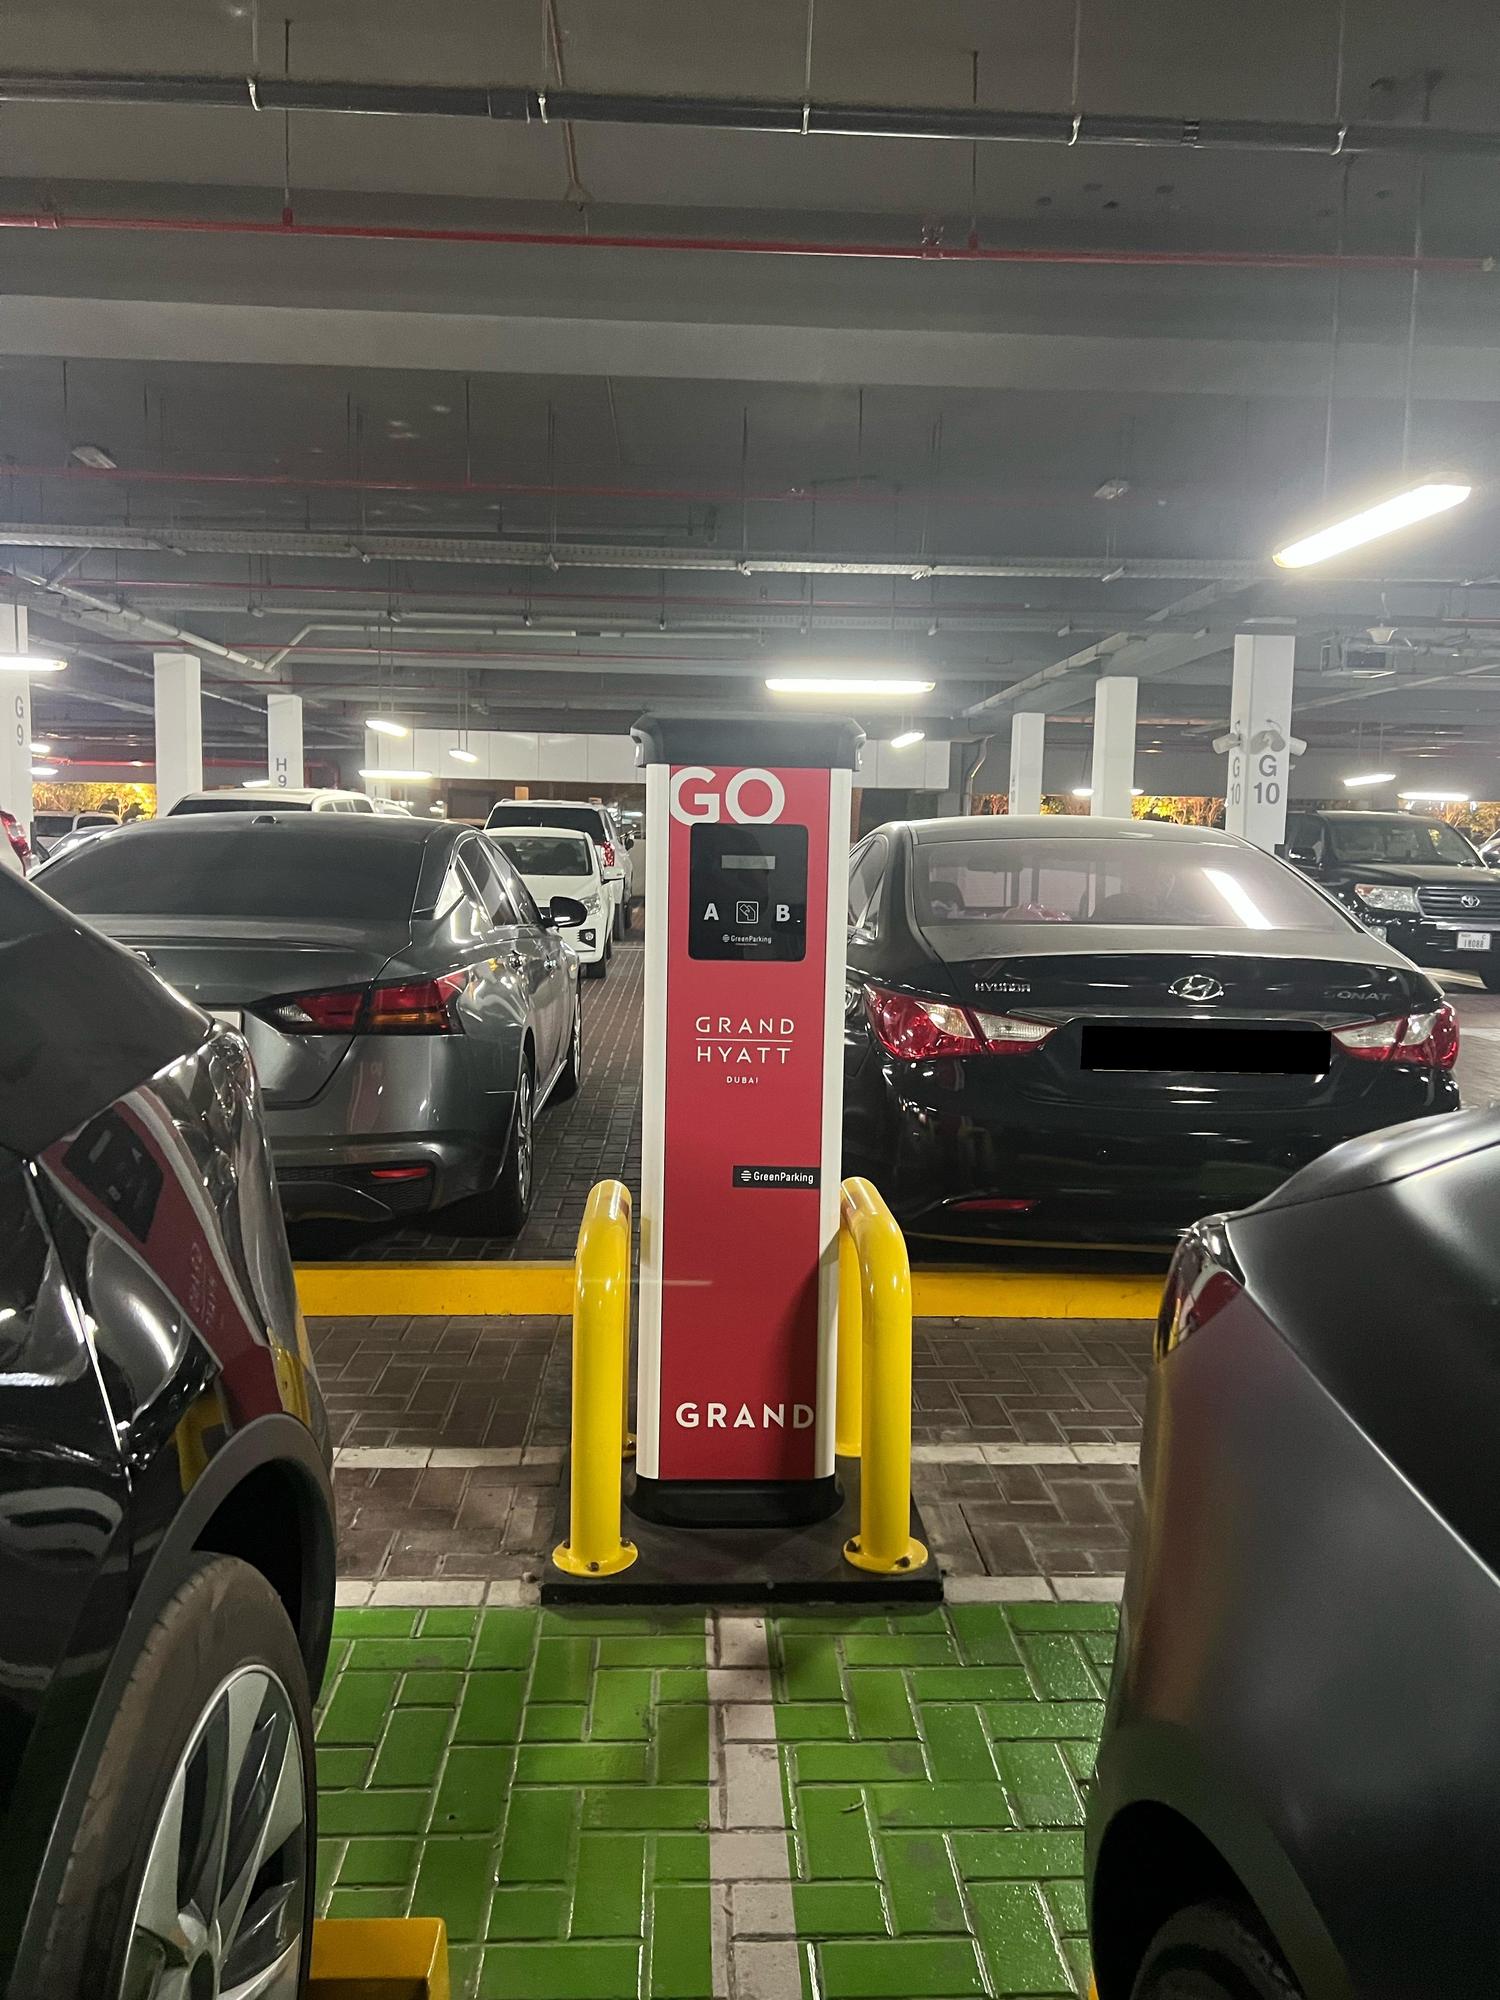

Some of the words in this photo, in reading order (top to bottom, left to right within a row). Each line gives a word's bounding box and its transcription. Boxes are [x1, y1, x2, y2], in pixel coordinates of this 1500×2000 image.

[15, 695, 24, 719] G
[16, 724, 24, 746] 9
[276, 757, 287, 772] H
[1232, 756, 1240, 778] G
[1259, 754, 1277, 777] G
[278, 774, 287, 788] 9
[670, 766, 785, 826] GO
[1231, 783, 1241, 805] 10
[1253, 781, 1280, 804] 10
[703, 902, 719, 921] A
[775, 904, 791, 922] B
[730, 934, 772, 944] GreenParking
[1323, 990, 1394, 1001] ONAT
[695, 1016, 795, 1035] GRAND
[697, 1046, 791, 1064] HYATT
[726, 1076, 759, 1084] DUBAI
[753, 1171, 814, 1184] GreenParking
[675, 1402, 815, 1429] GRAND
